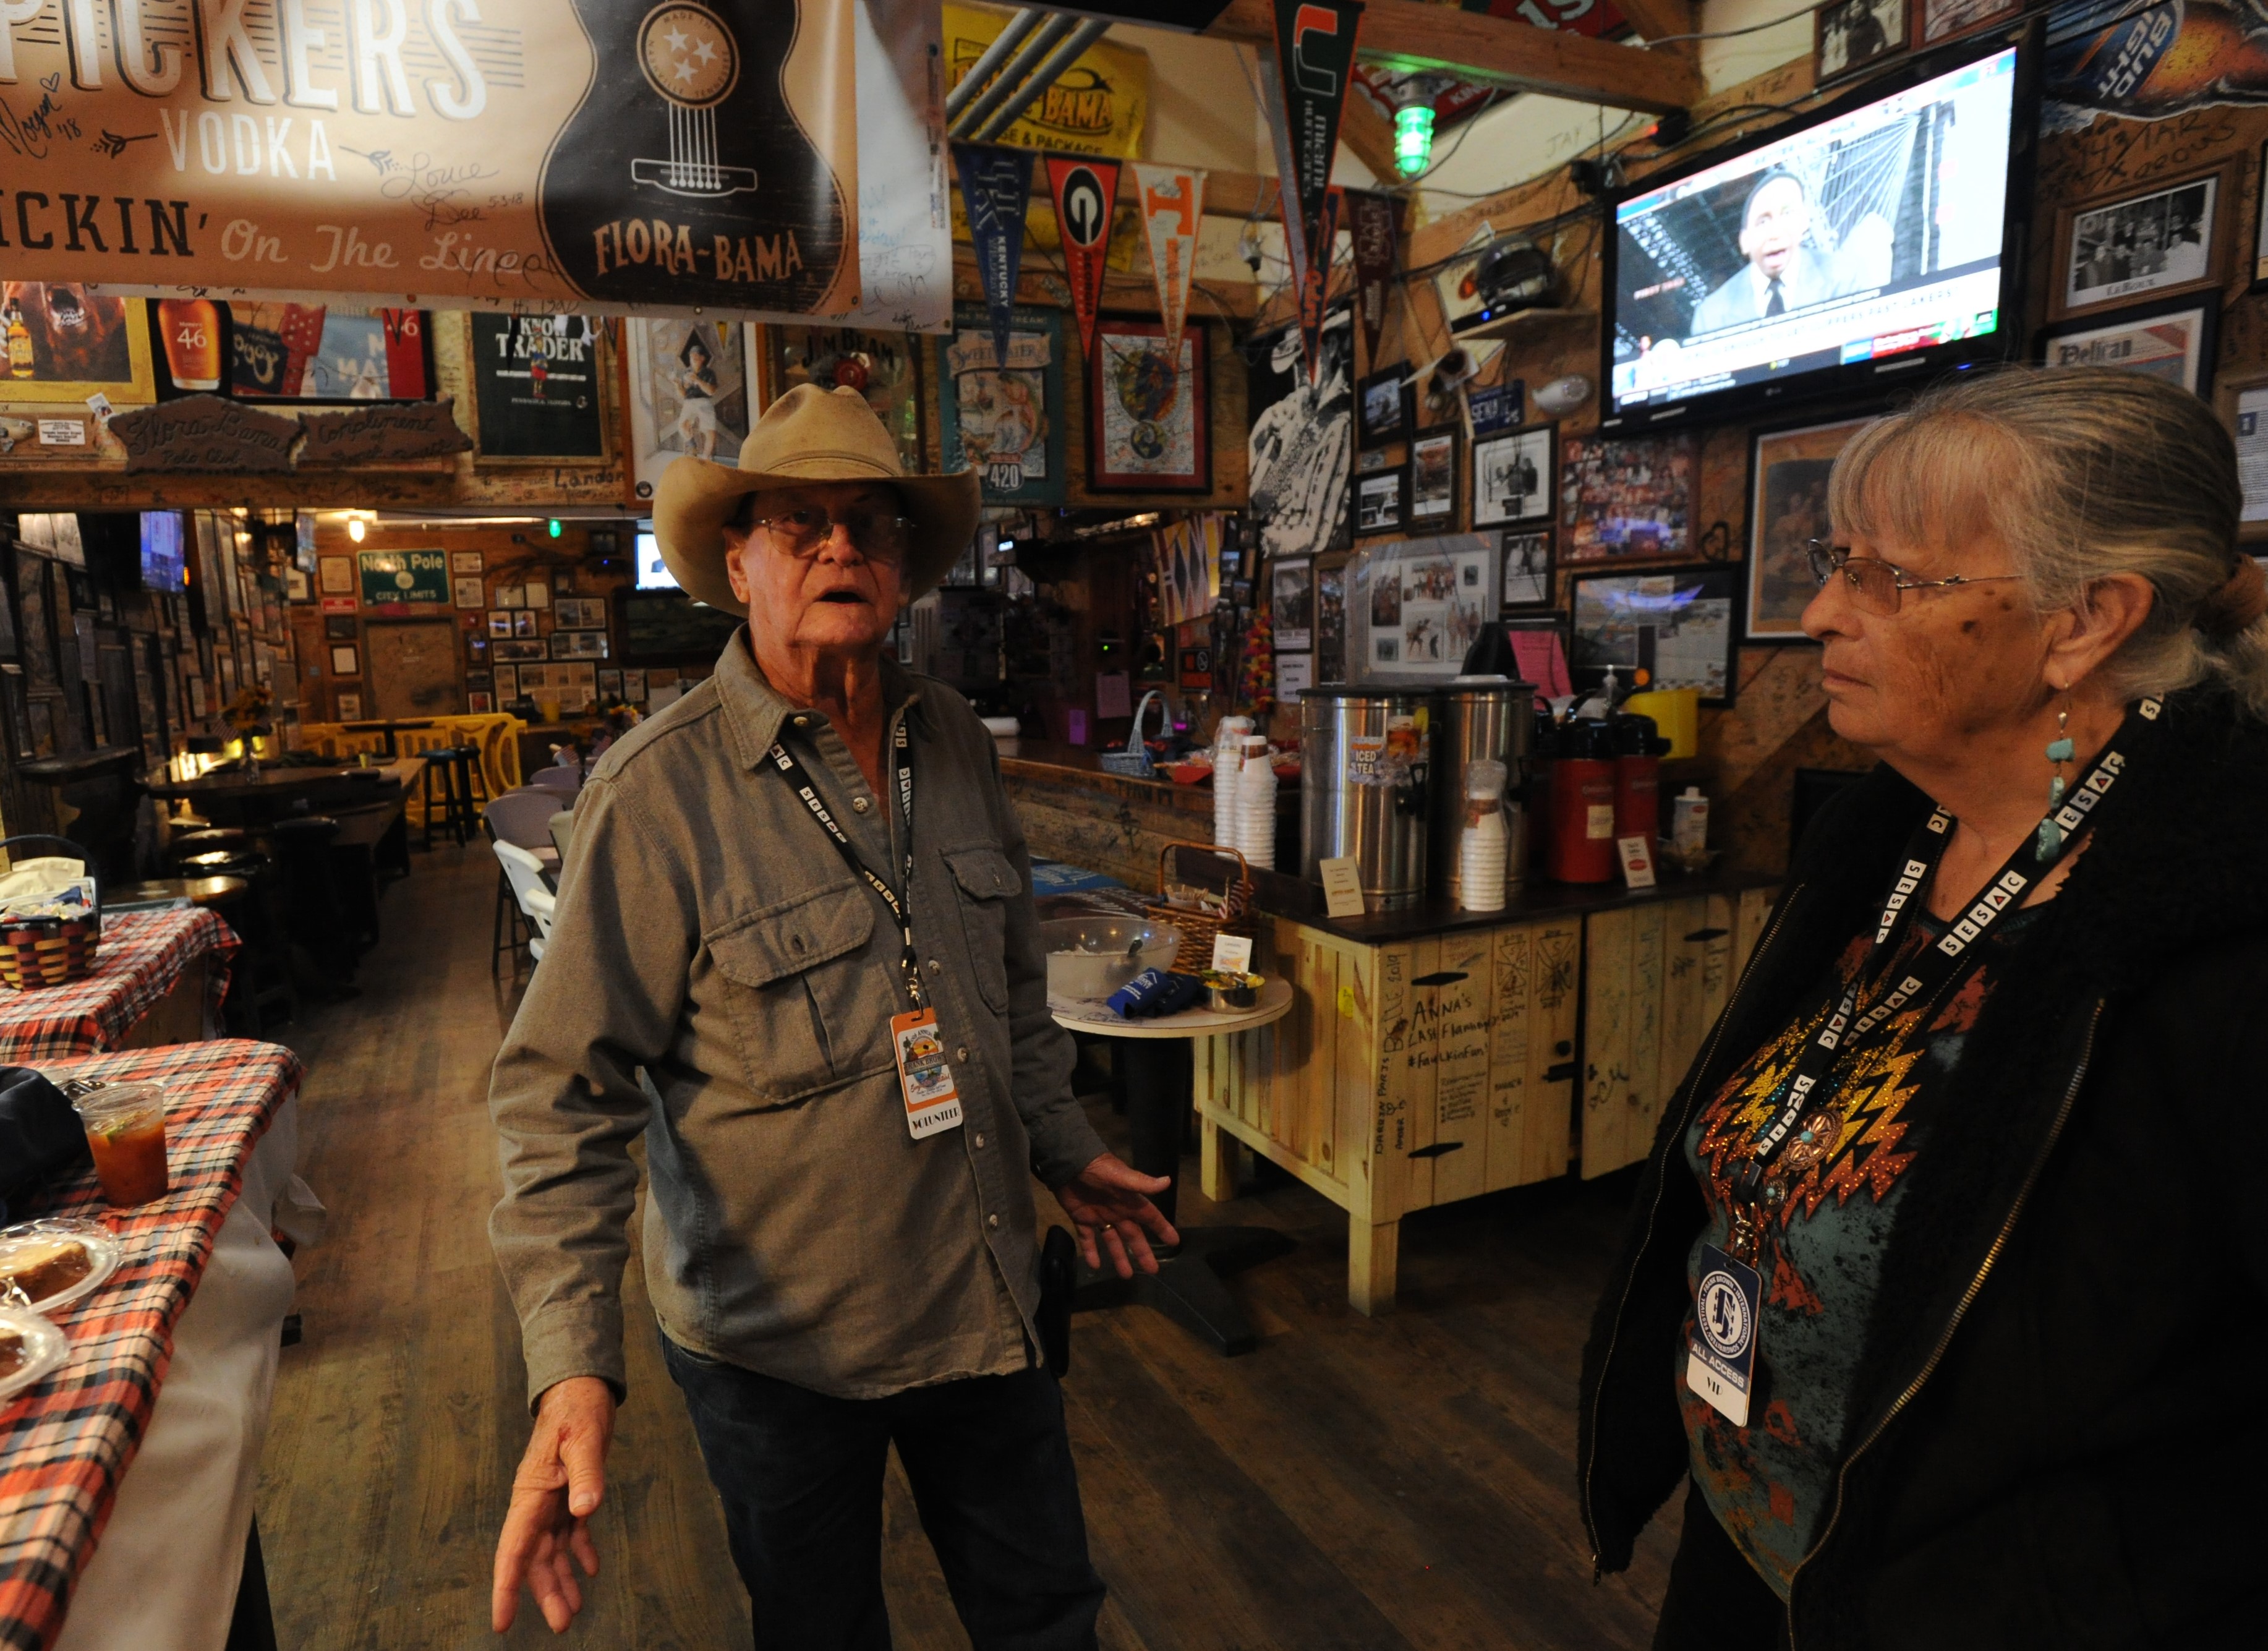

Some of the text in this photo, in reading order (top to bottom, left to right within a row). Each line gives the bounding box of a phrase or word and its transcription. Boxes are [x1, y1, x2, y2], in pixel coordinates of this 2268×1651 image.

[0, 0, 487, 119] PICKERS
[2097, 10, 2156, 100] IGHT
[2112, 11, 2173, 98] BUD
[160, 108, 338, 182] VODKA
[0, 189, 208, 257] CKIN'
[221, 218, 286, 262] On
[310, 224, 399, 273] The
[592, 218, 805, 285] FLORA-BAMA
[998, 235, 1009, 308] KENTUCKY
[177, 327, 208, 350] 46
[495, 332, 585, 362] TRADER
[990, 464, 1020, 488] 420
[411, 553, 444, 570] Pole
[1355, 749, 1377, 762] ICED
[1357, 762, 1375, 774] TEA
[1876, 861, 1925, 942] SESAC
[1940, 873, 2025, 955] SESAC
[912, 1106, 960, 1130] VOLUNTEER
[1703, 1276, 1716, 1294] FRANK
[1716, 1275, 1734, 1289] BROWN
[1734, 1289, 1749, 1347] INTERNATIONAL
[1692, 1342, 1744, 1388] ALL ACCESS
[1707, 1375, 1723, 1396] VIP
